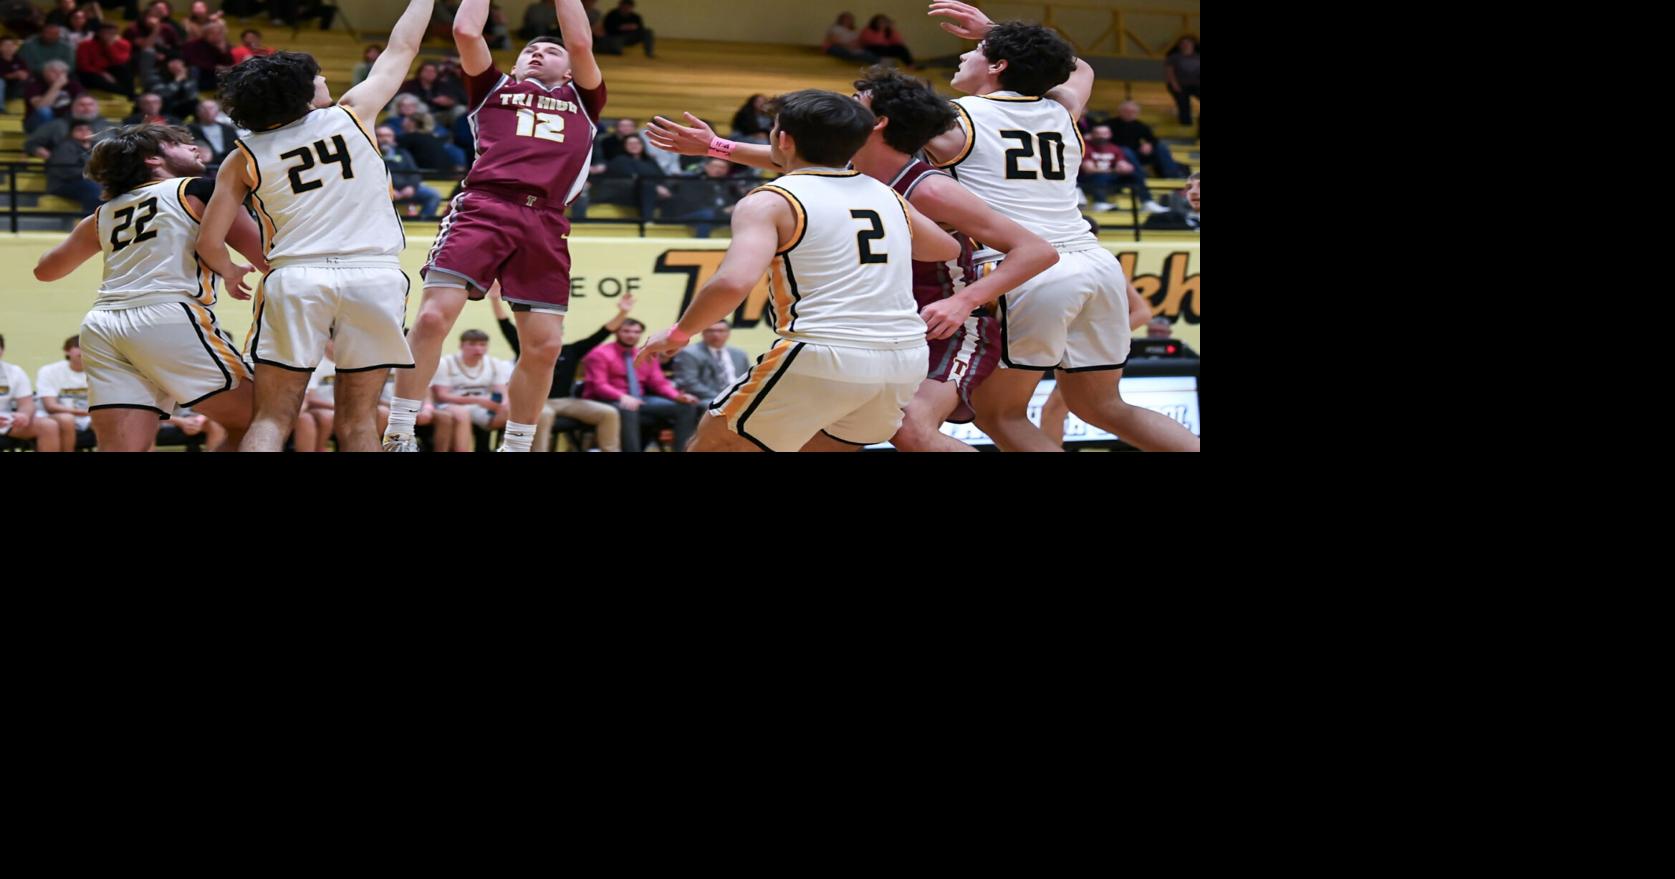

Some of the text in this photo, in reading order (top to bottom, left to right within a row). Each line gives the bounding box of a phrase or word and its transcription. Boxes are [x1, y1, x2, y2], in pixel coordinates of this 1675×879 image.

[499, 93, 534, 107] TRI
[515, 108, 565, 143] 12
[280, 134, 354, 195] 24
[999, 129, 1066, 181] 20
[110, 196, 158, 252] 22
[849, 208, 888, 264] 2
[598, 277, 641, 297] OF
[954, 358, 968, 375] T
